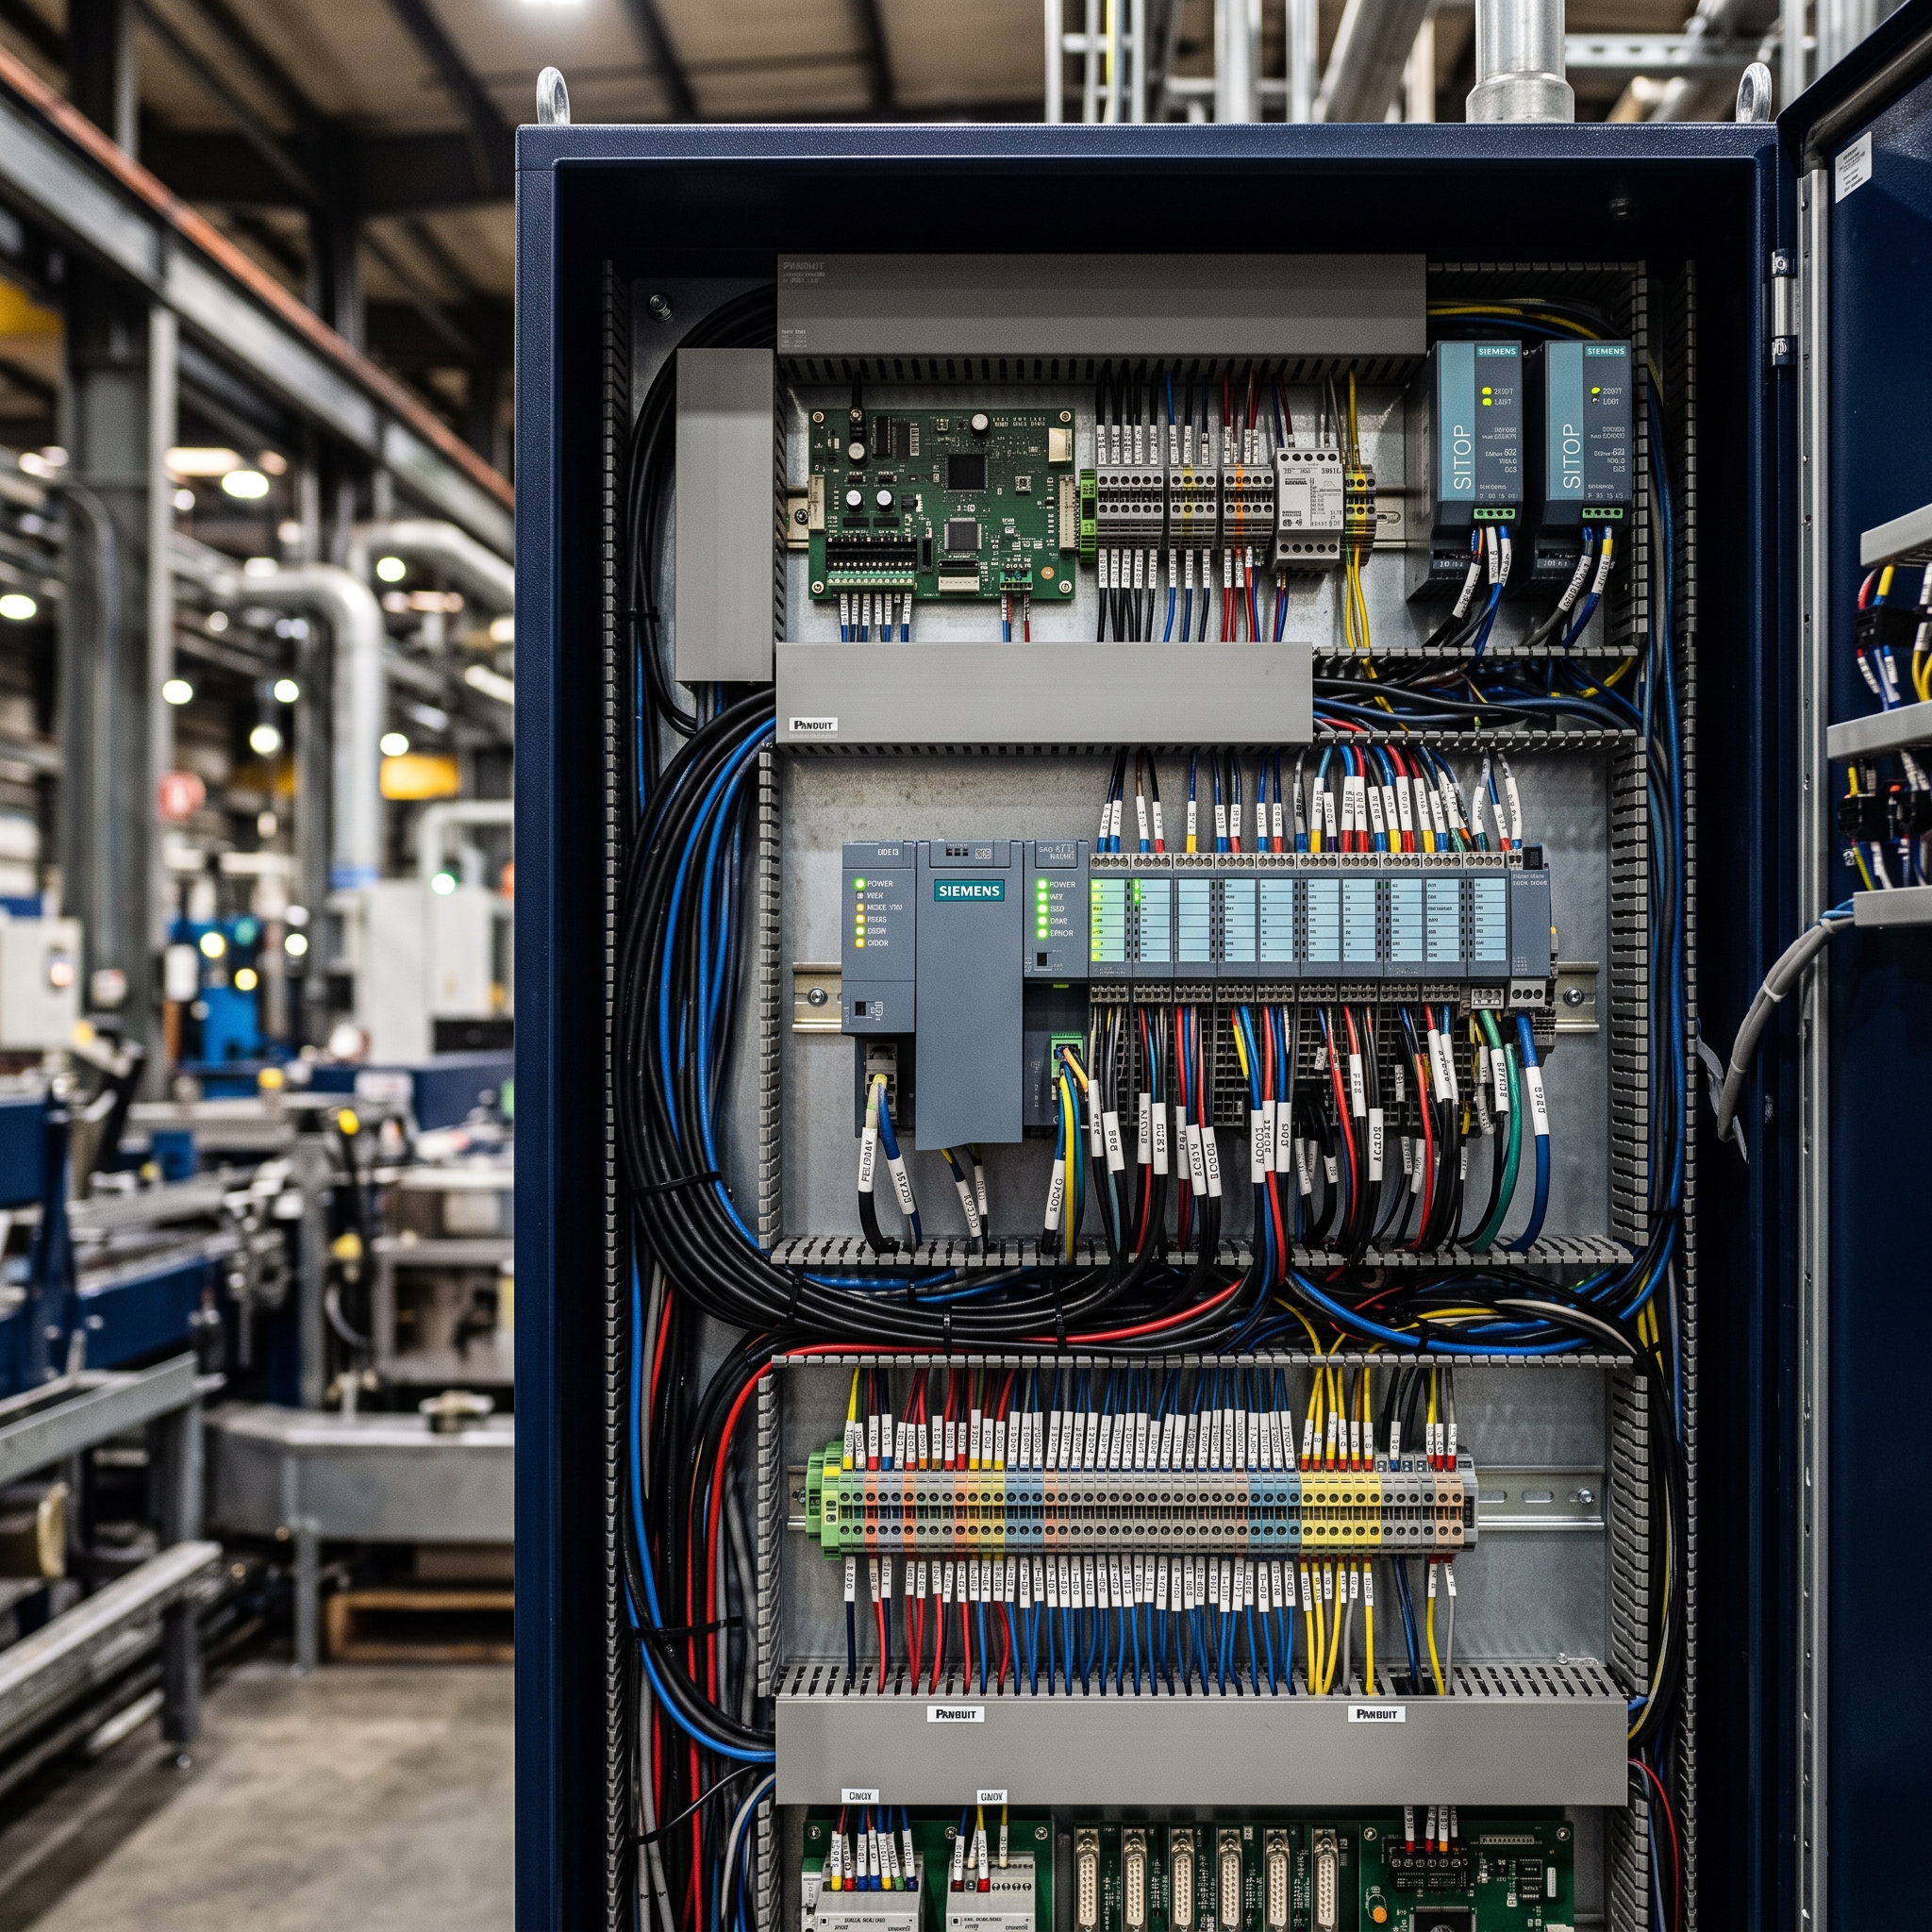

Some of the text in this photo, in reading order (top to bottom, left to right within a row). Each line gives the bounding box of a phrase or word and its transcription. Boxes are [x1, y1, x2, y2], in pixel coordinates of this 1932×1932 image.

[1453, 425, 1472, 489] SITOP
[1562, 424, 1581, 489] SITOP
[794, 721, 833, 730] PANDUIT
[940, 885, 1000, 896] SIEMENS
